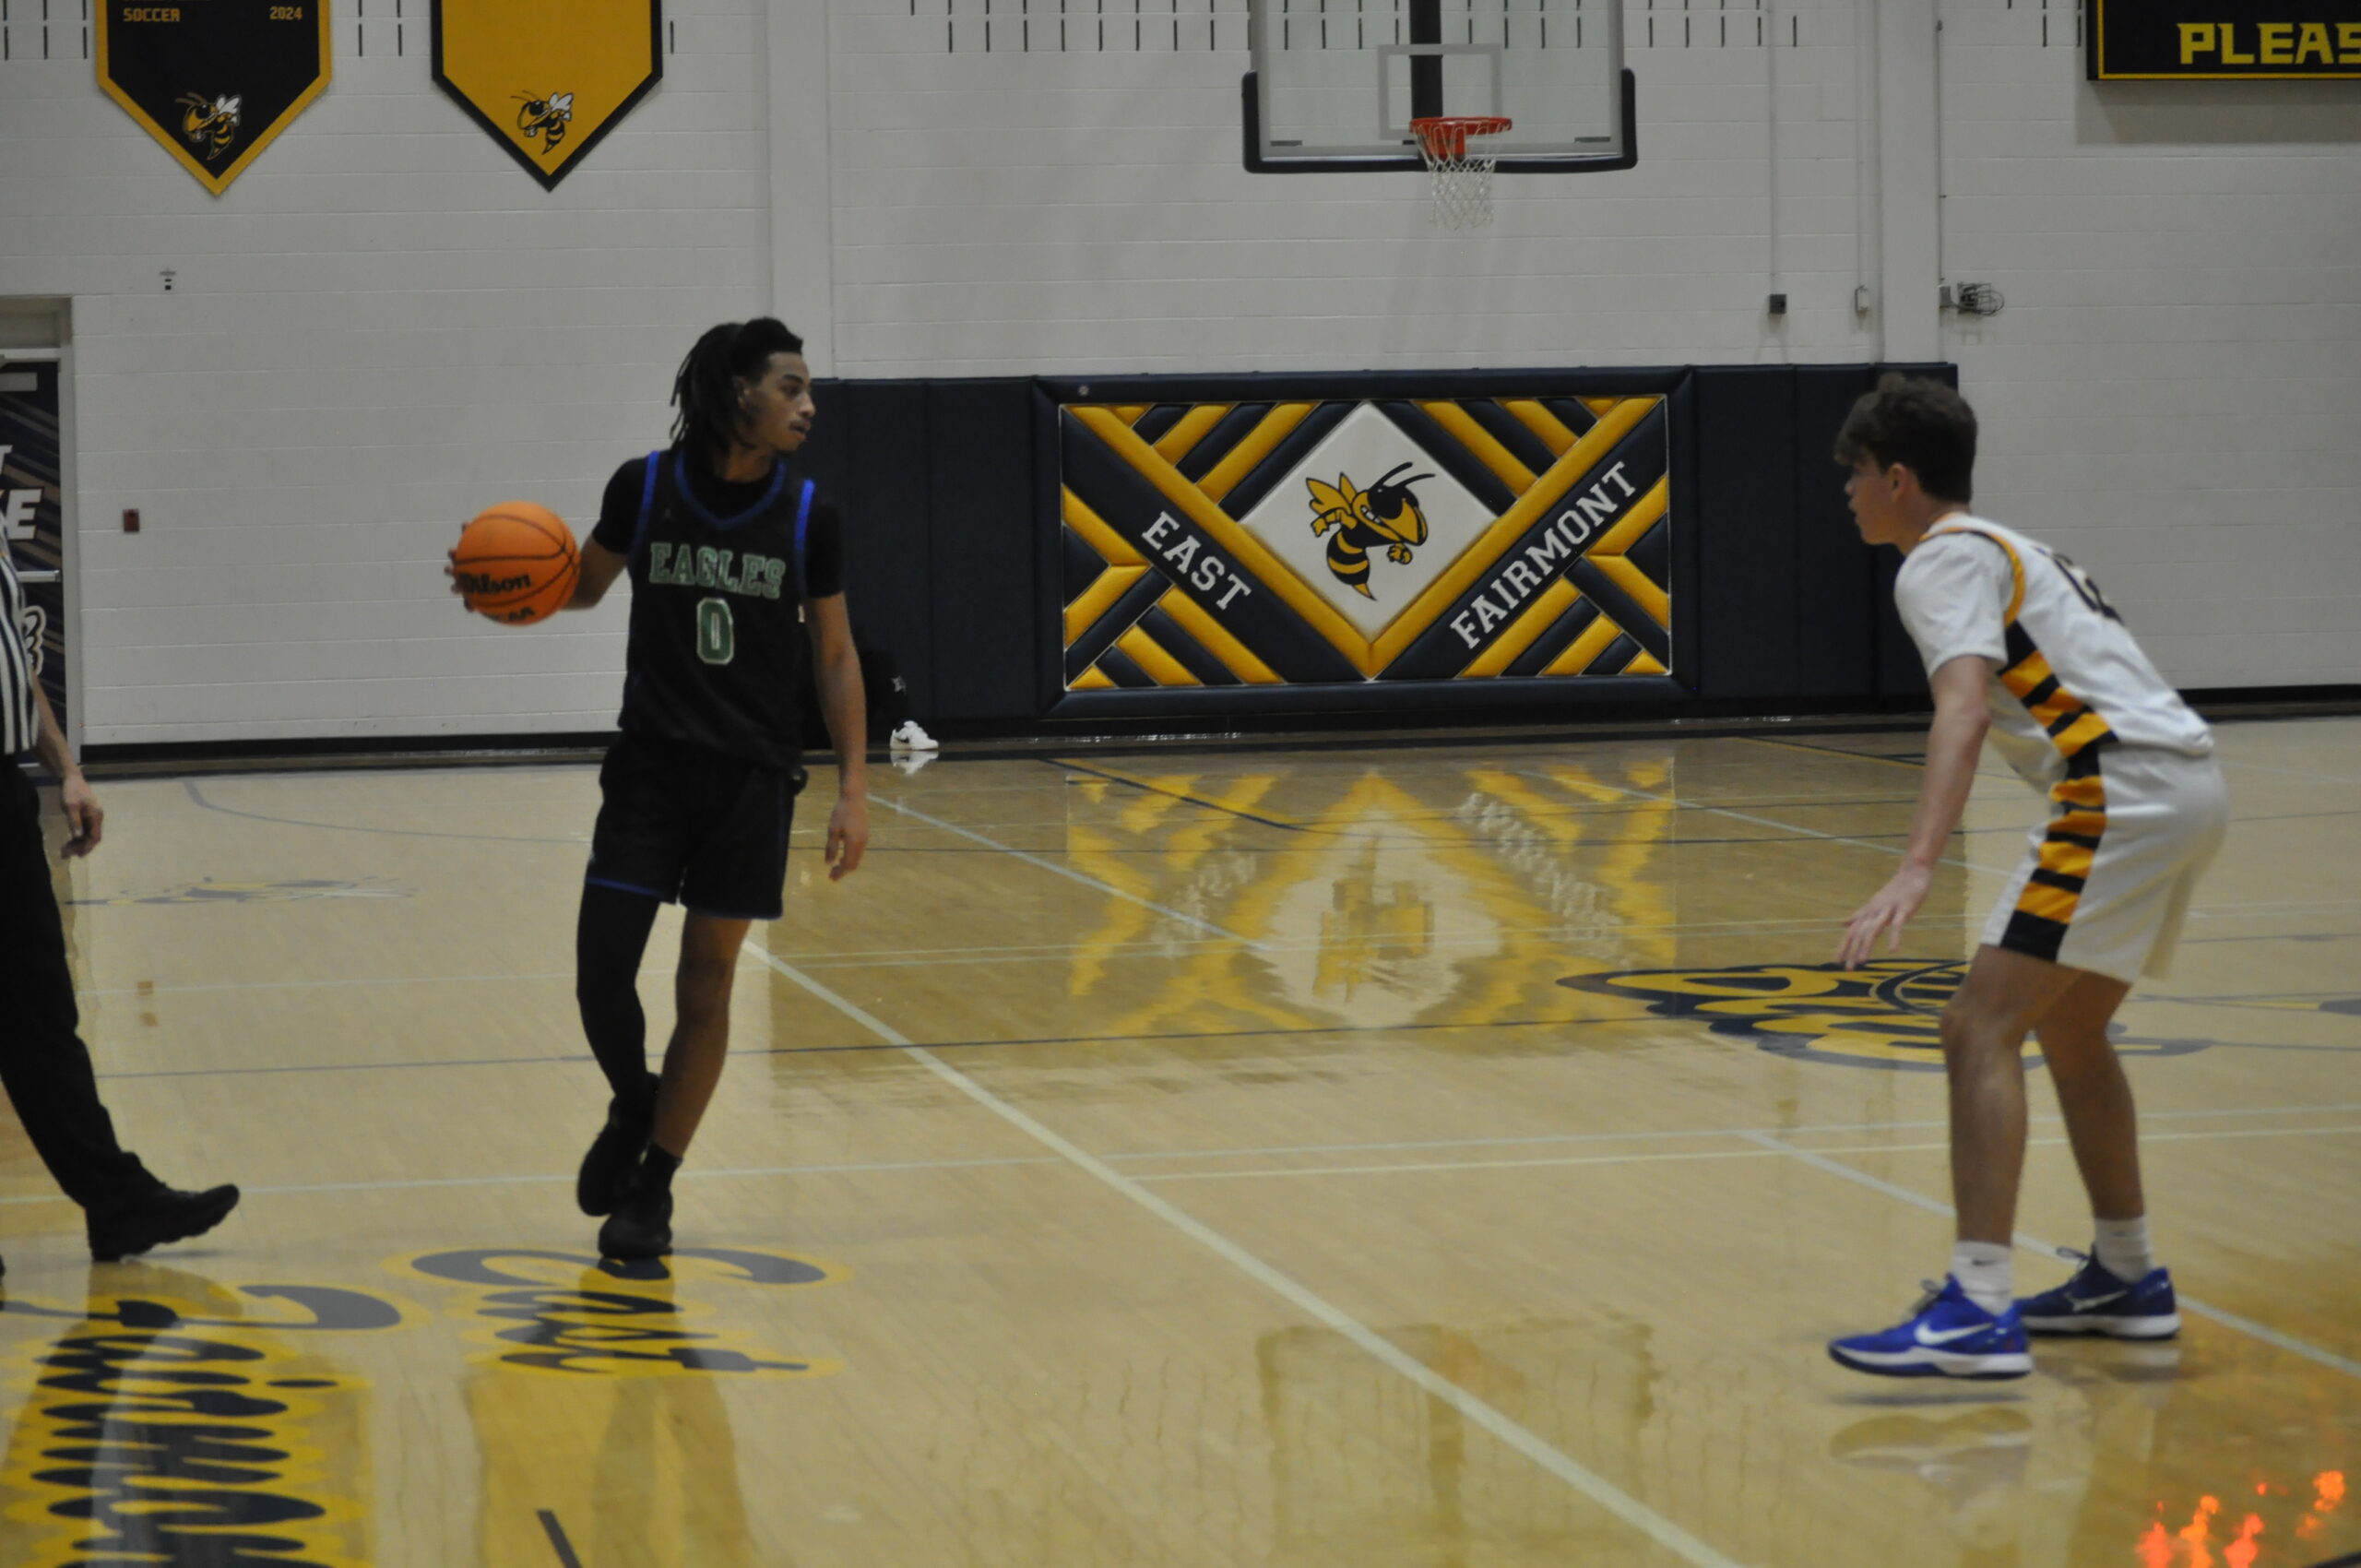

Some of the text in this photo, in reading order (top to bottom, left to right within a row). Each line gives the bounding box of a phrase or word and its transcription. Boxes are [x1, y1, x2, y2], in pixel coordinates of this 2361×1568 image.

[123, 6, 303, 22] SOCCER 2024
[457, 573, 531, 595] Wilson
[648, 541, 787, 600] EAGLES
[1141, 510, 1252, 612] EAST
[1450, 461, 1637, 649] FAIRMONT
[696, 597, 734, 666] 0
